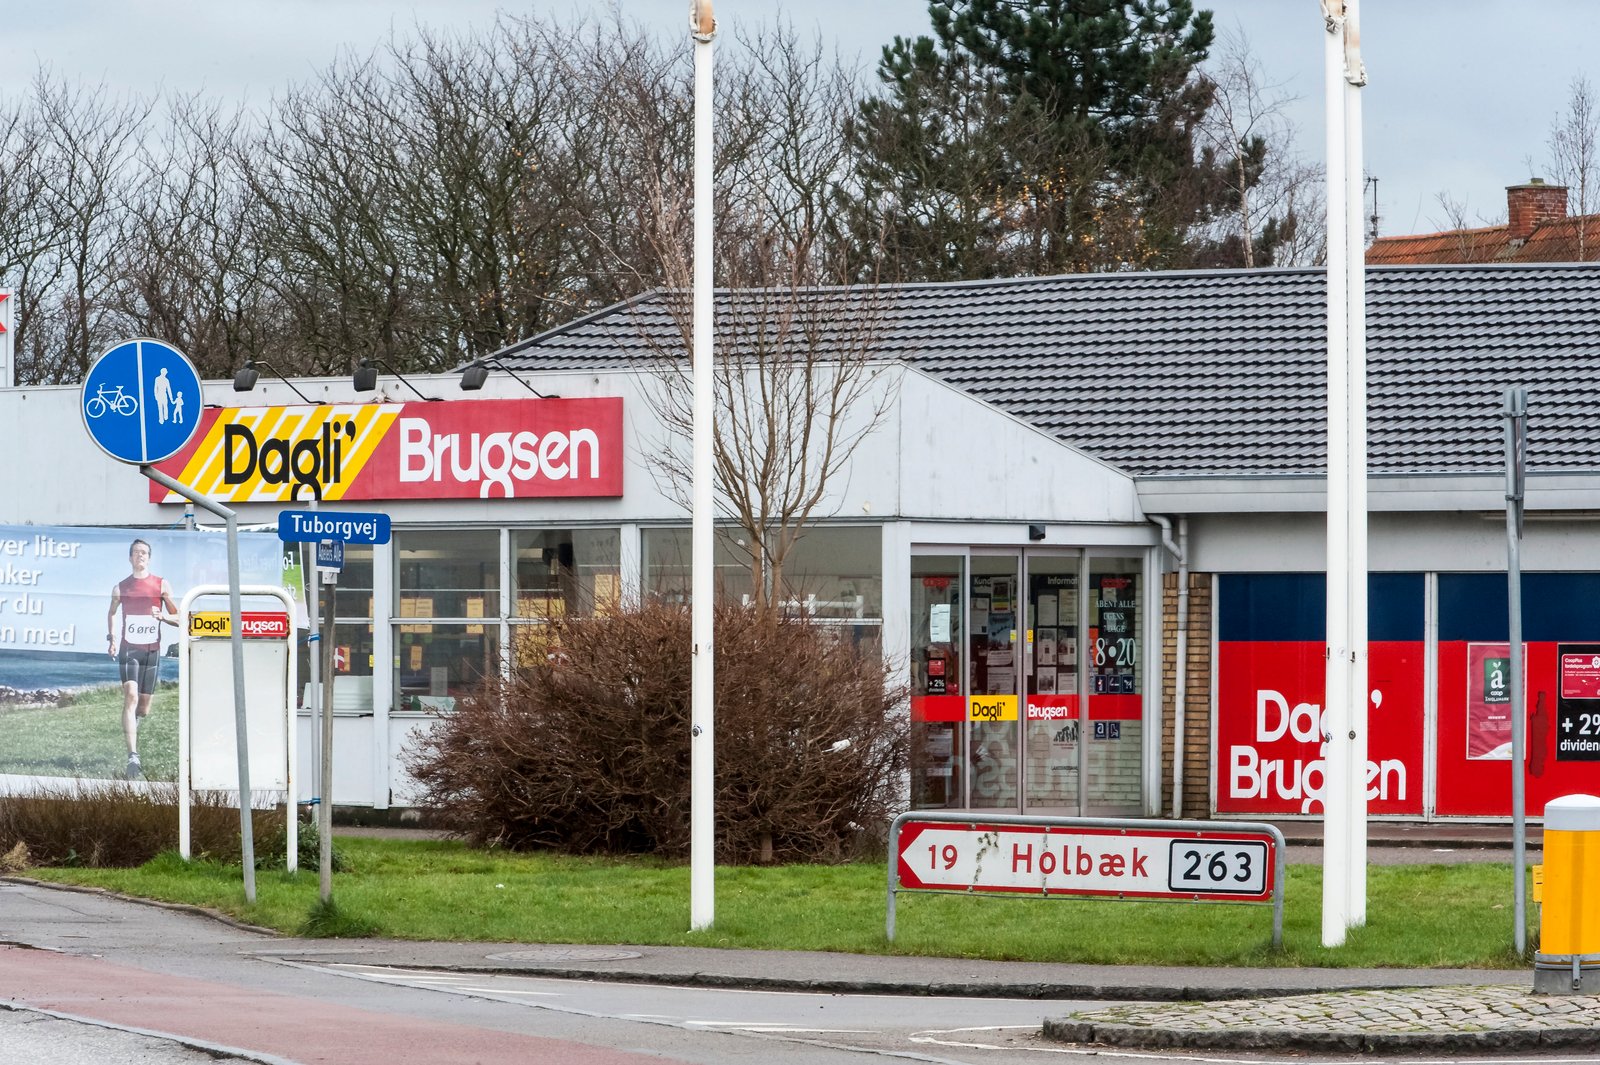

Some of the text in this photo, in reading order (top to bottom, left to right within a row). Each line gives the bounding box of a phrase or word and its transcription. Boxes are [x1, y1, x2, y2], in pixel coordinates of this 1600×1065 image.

[224, 418, 600, 501] Dagli' Brugsen
[291, 514, 377, 541] Tuborgvej
[34, 535, 81, 558] liter
[13, 593, 43, 615] du
[24, 624, 76, 646] med
[128, 623, 156, 634] 6 øre
[193, 617, 283, 634] Dagli' rugsen
[972, 702, 1068, 721] Dagli' Brugsen
[1560, 739, 1600, 751] dividen
[1230, 745, 1407, 814] Brugen
[928, 843, 1253, 883] 19 Holbæk 263
